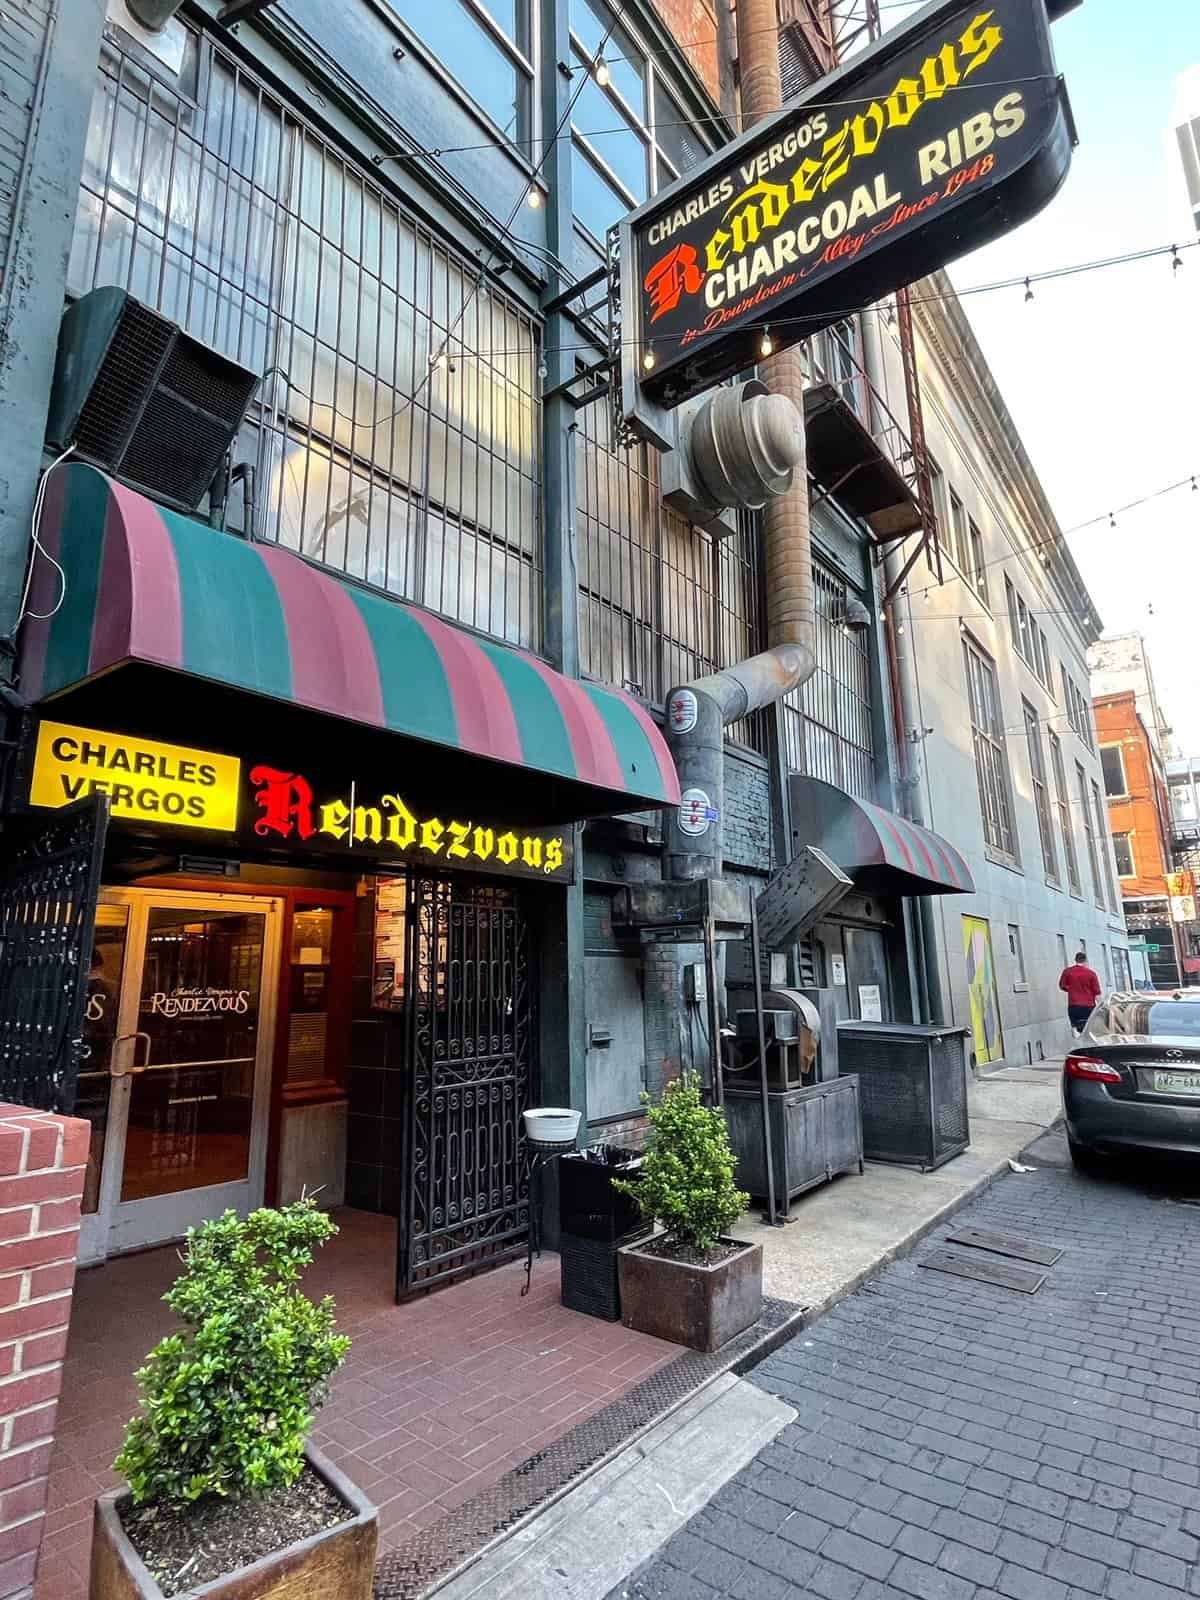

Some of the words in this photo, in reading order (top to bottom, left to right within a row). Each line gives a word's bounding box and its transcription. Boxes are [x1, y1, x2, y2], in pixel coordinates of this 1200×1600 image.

[644, 9, 1004, 324] Rendezvous
[647, 174, 735, 247] CHARLES
[738, 111, 828, 185] VERGO'S
[704, 173, 902, 310] CHARCOAL
[917, 91, 1026, 187] RIBS
[702, 273, 798, 334] Downtown
[800, 231, 866, 279] Alley
[871, 190, 942, 234] Since
[941, 152, 995, 198] 1948
[51, 736, 217, 787] CHARLES
[60, 773, 207, 819] VERGOS
[249, 765, 564, 875] Rendezvous
